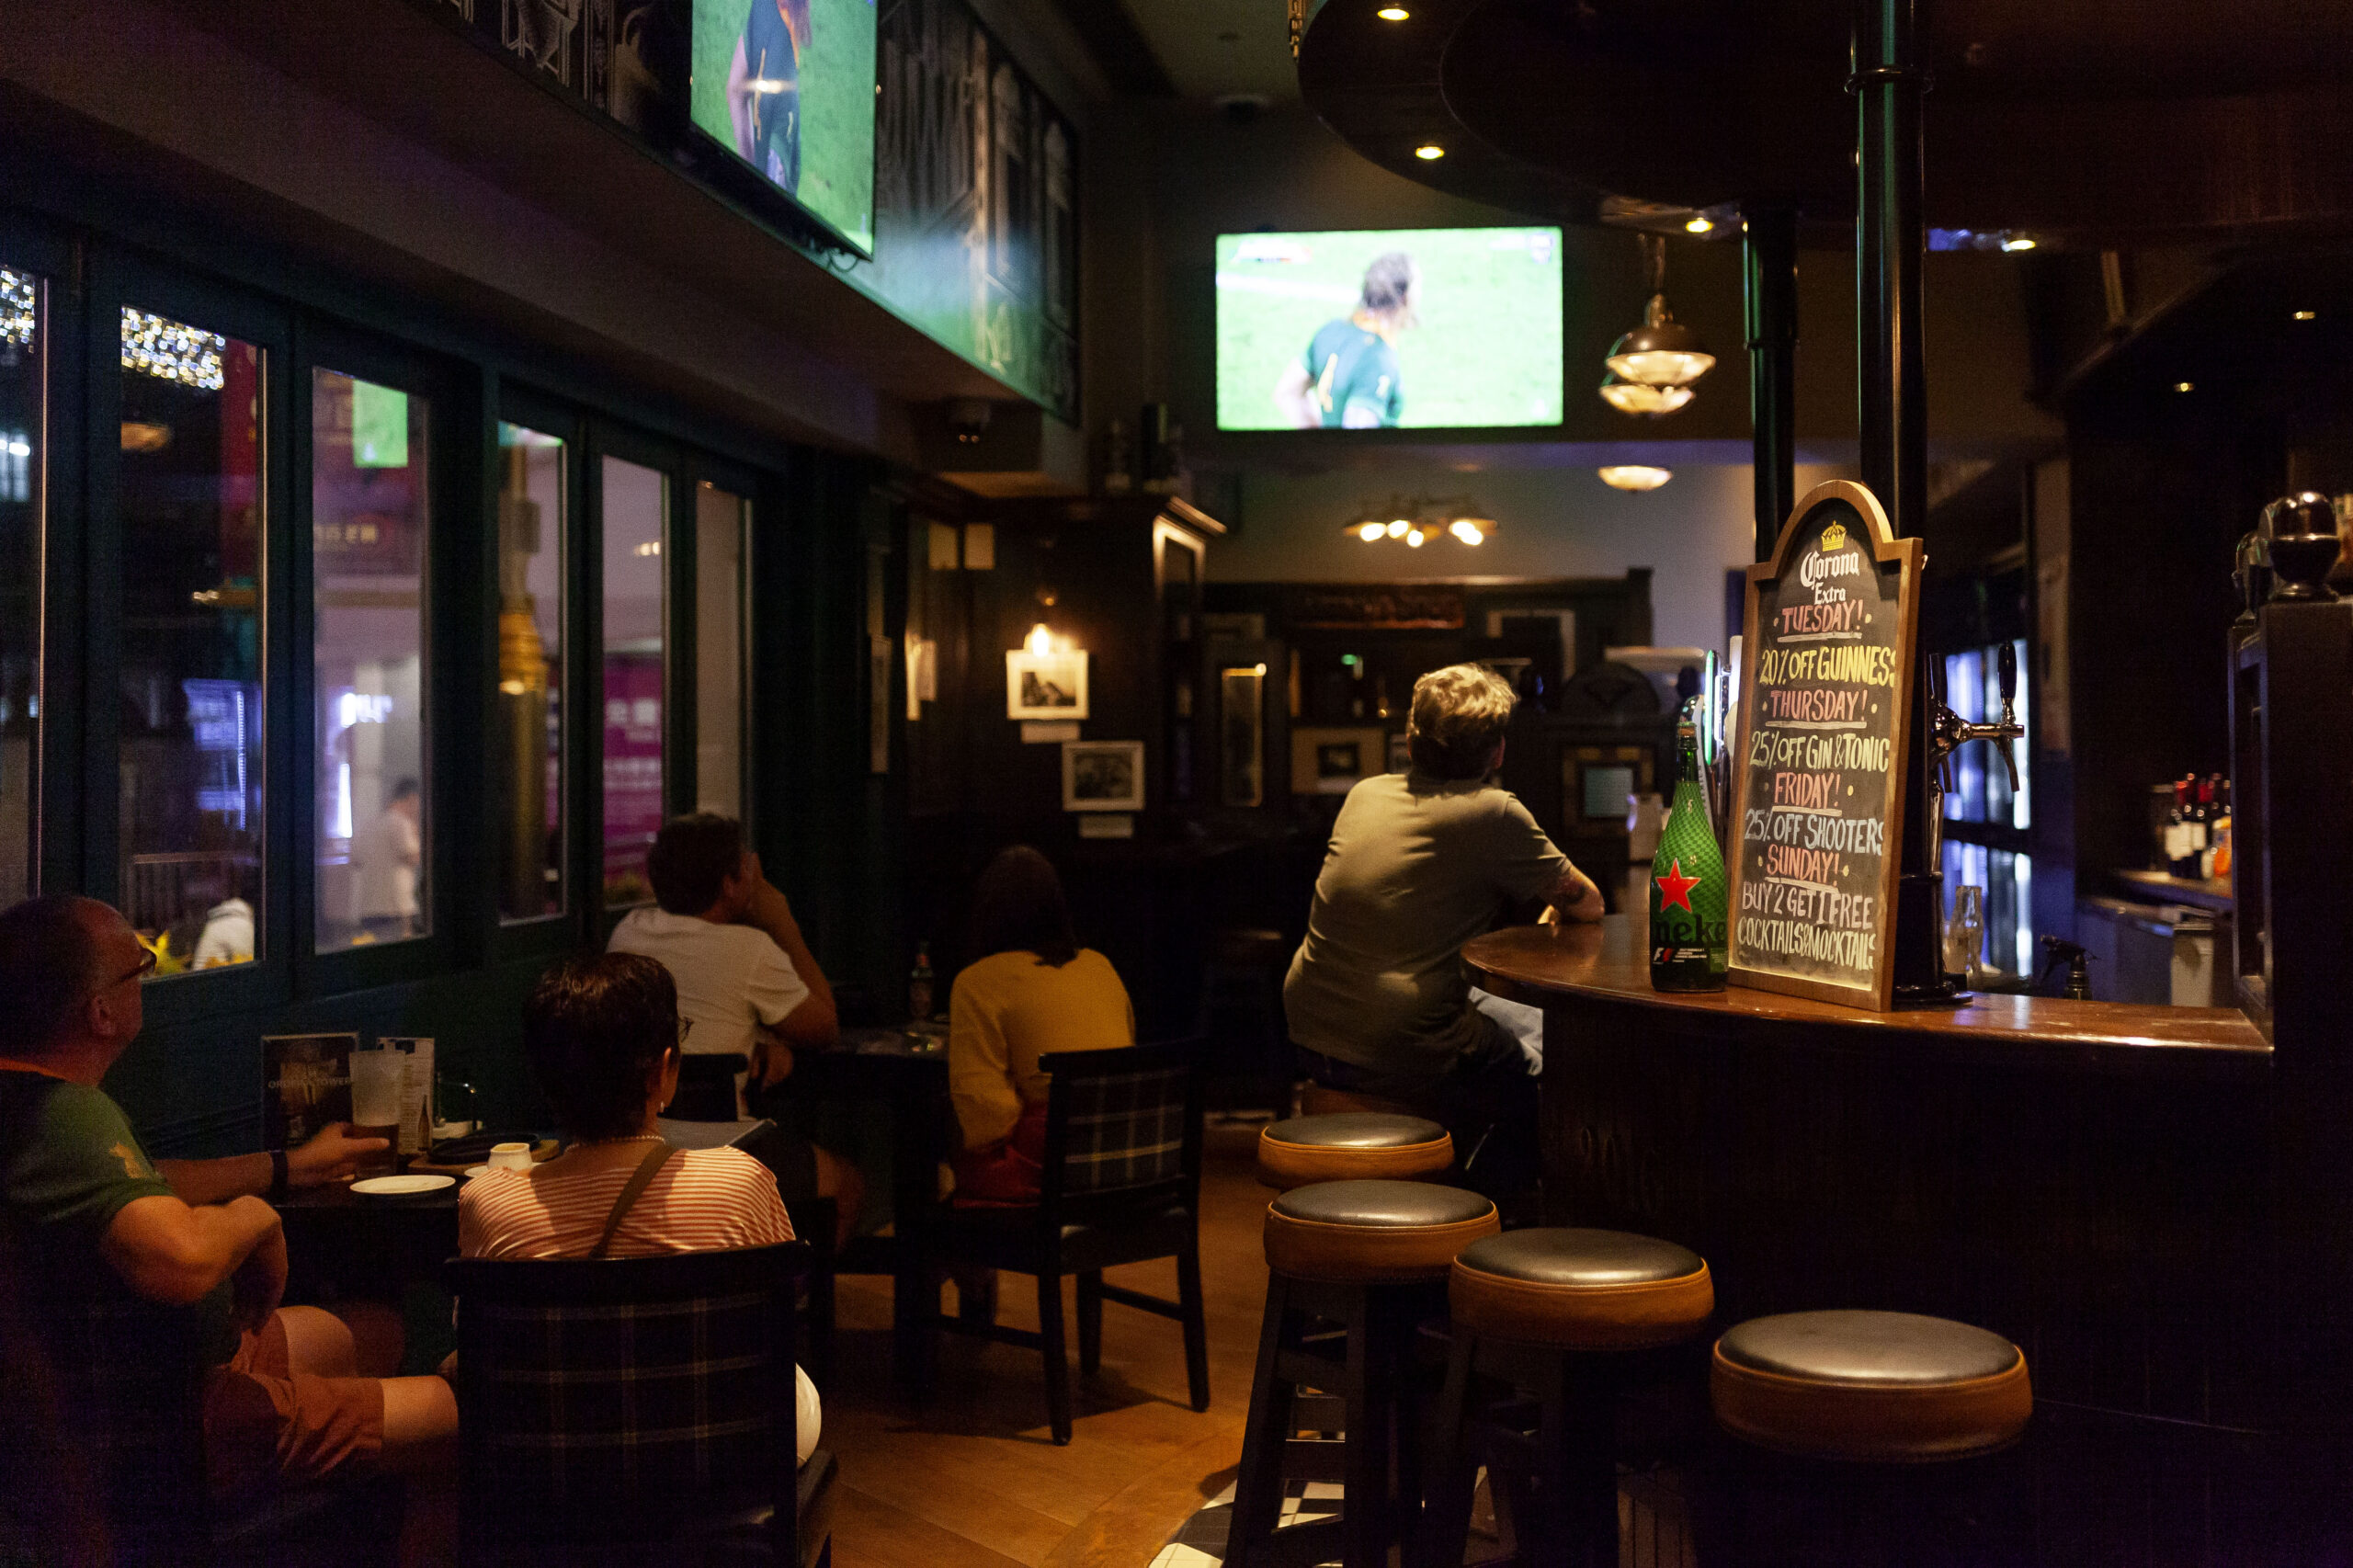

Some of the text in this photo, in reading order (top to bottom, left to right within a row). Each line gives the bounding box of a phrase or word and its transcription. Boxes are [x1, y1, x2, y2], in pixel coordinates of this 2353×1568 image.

[1800, 551, 1859, 590] Corona
[1813, 582, 1847, 605] Extra
[1781, 599, 1864, 633] TUESDAY!
[1759, 649, 1787, 686] 20%
[1789, 649, 1817, 681] OFF
[1770, 689, 1868, 722] THURSDAY!
[1749, 731, 1779, 770] 25%
[1778, 735, 1804, 769] OFF
[1806, 734, 1832, 770] GIN
[1775, 772, 1841, 809] FRIDAY!
[1745, 809, 1774, 842] 25%
[1774, 812, 1803, 845] OFF
[1767, 844, 1840, 886] SUNDAY!
[1743, 881, 1772, 915] BUY
[1774, 884, 1785, 915] 2
[1787, 887, 1816, 918] GET
[1828, 894, 1873, 929] FREE
